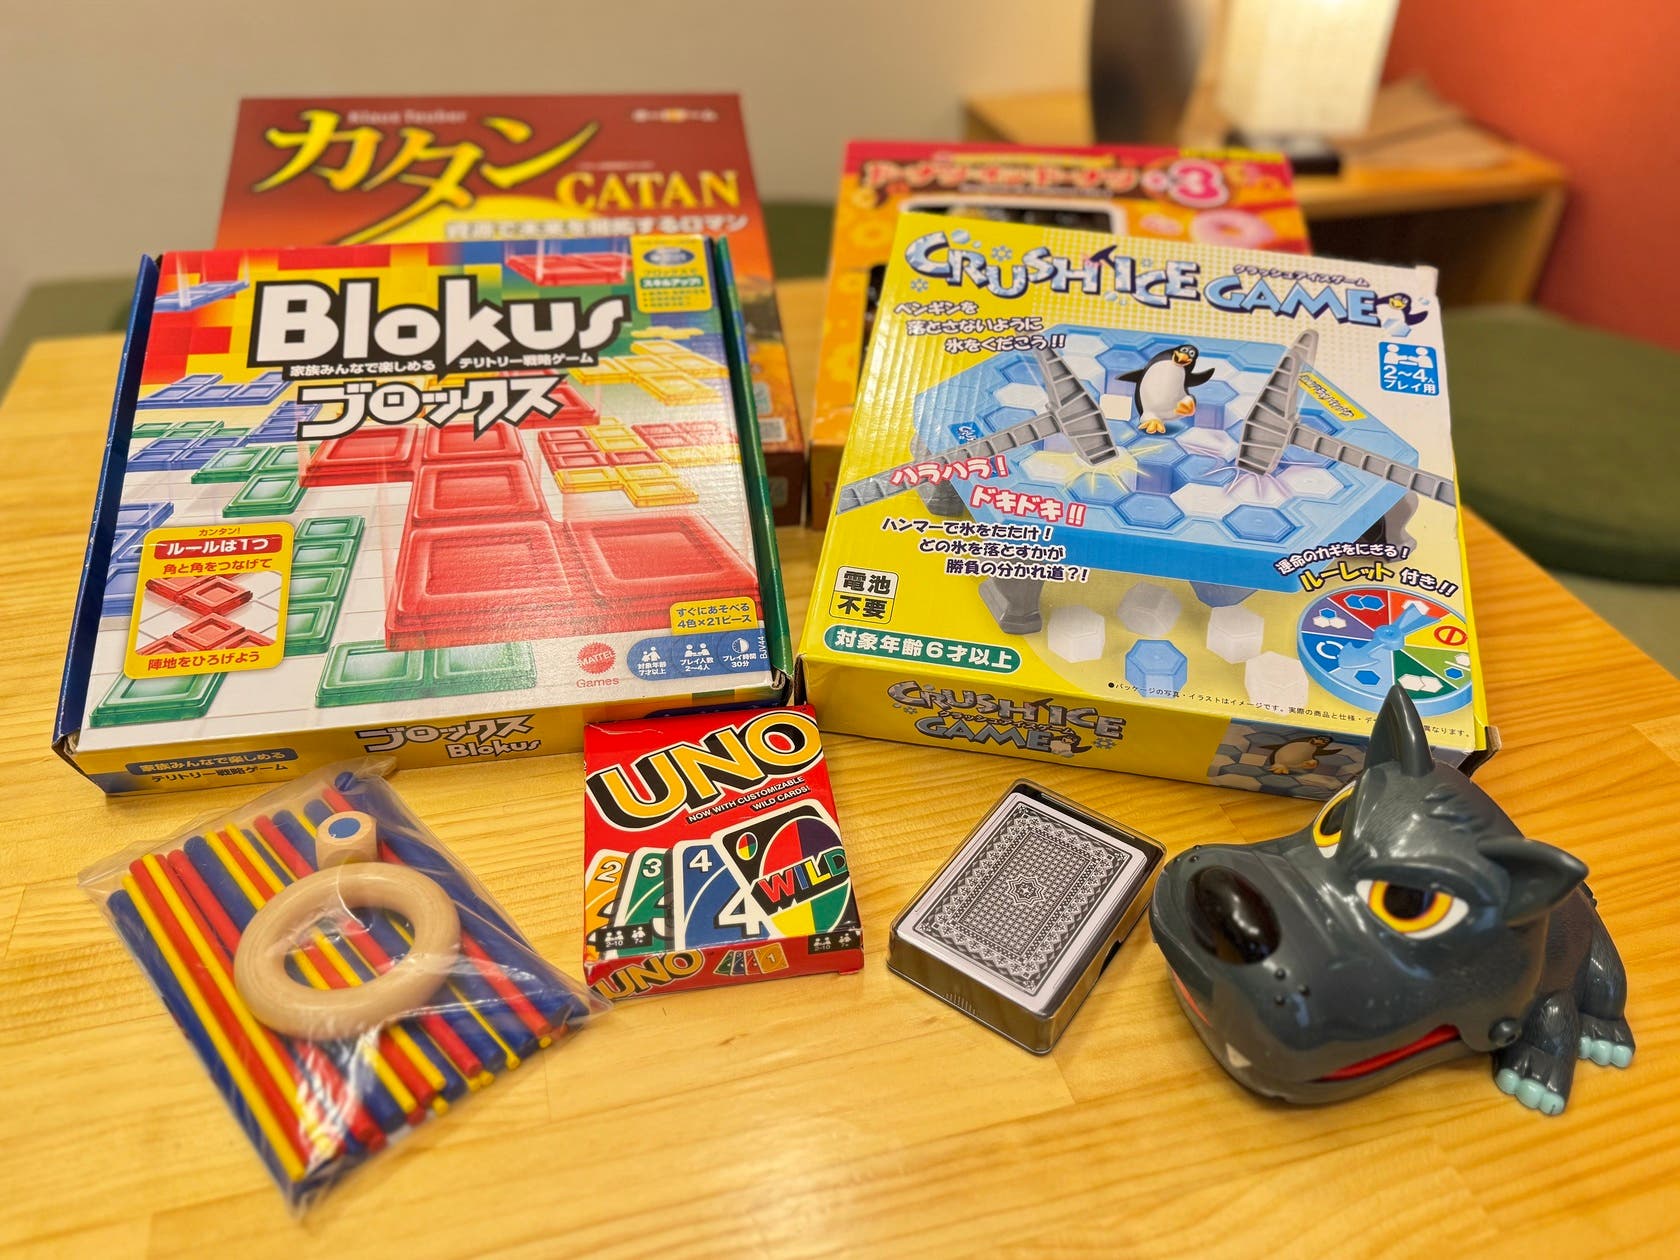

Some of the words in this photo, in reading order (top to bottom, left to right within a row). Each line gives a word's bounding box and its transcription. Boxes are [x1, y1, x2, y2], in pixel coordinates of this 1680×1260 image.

[250, 108, 601, 244] カタン
[1174, 162, 1224, 203] 3
[556, 169, 741, 212] CATAN
[904, 231, 1101, 299] CRUSH
[1114, 255, 1201, 309] ICE
[894, 301, 979, 316] ペンギンを
[1203, 275, 1382, 328] GAME
[252, 276, 627, 370] Blokus
[906, 317, 1043, 336] 落とさないように
[289, 358, 436, 378] 家族みんなで楽しめる
[458, 352, 595, 370] テリトリー戦略ゲーム
[1383, 379, 1437, 395] プレイ用
[299, 376, 562, 439] ブロックス
[199, 528, 241, 537] カンタン!
[166, 538, 270, 556] ルールは1つ
[919, 538, 1065, 561] どの氷を落とすかが
[163, 558, 273, 575] 角と角をつなげて
[1299, 561, 1395, 592] ルーレット
[842, 570, 891, 595] 電池
[676, 603, 750, 618] すぐにあそべる
[837, 594, 888, 620] 不要
[677, 614, 752, 629] 4色×21ピース
[147, 651, 261, 671] 陣地をひろげよう
[680, 657, 714, 666] プレイ人数
[722, 653, 757, 662] プレイ時間
[834, 628, 1013, 670] 対象年齢6才以上
[576, 677, 620, 688] Games
[888, 680, 1041, 722] CRUSH
[1049, 704, 1127, 740] ICE
[354, 714, 536, 753] ブロックス
[914, 716, 1053, 752] GAME
[446, 739, 542, 759] Blokus
[139, 752, 286, 772] 家族みんなで楽しめる
[151, 764, 289, 783] テリトリー戦略ゲーム
[586, 710, 823, 831] UNO
[688, 809, 711, 822] NOW
[712, 801, 737, 813] WITH
[738, 776, 805, 805] CUSTOMIZABLE
[752, 797, 776, 811] WILD
[777, 785, 811, 801] CARDS!
[594, 860, 623, 883] 2
[642, 857, 663, 878] 3
[690, 849, 713, 872] 4
[757, 849, 850, 907] WILD
[594, 949, 705, 1001] UNO
